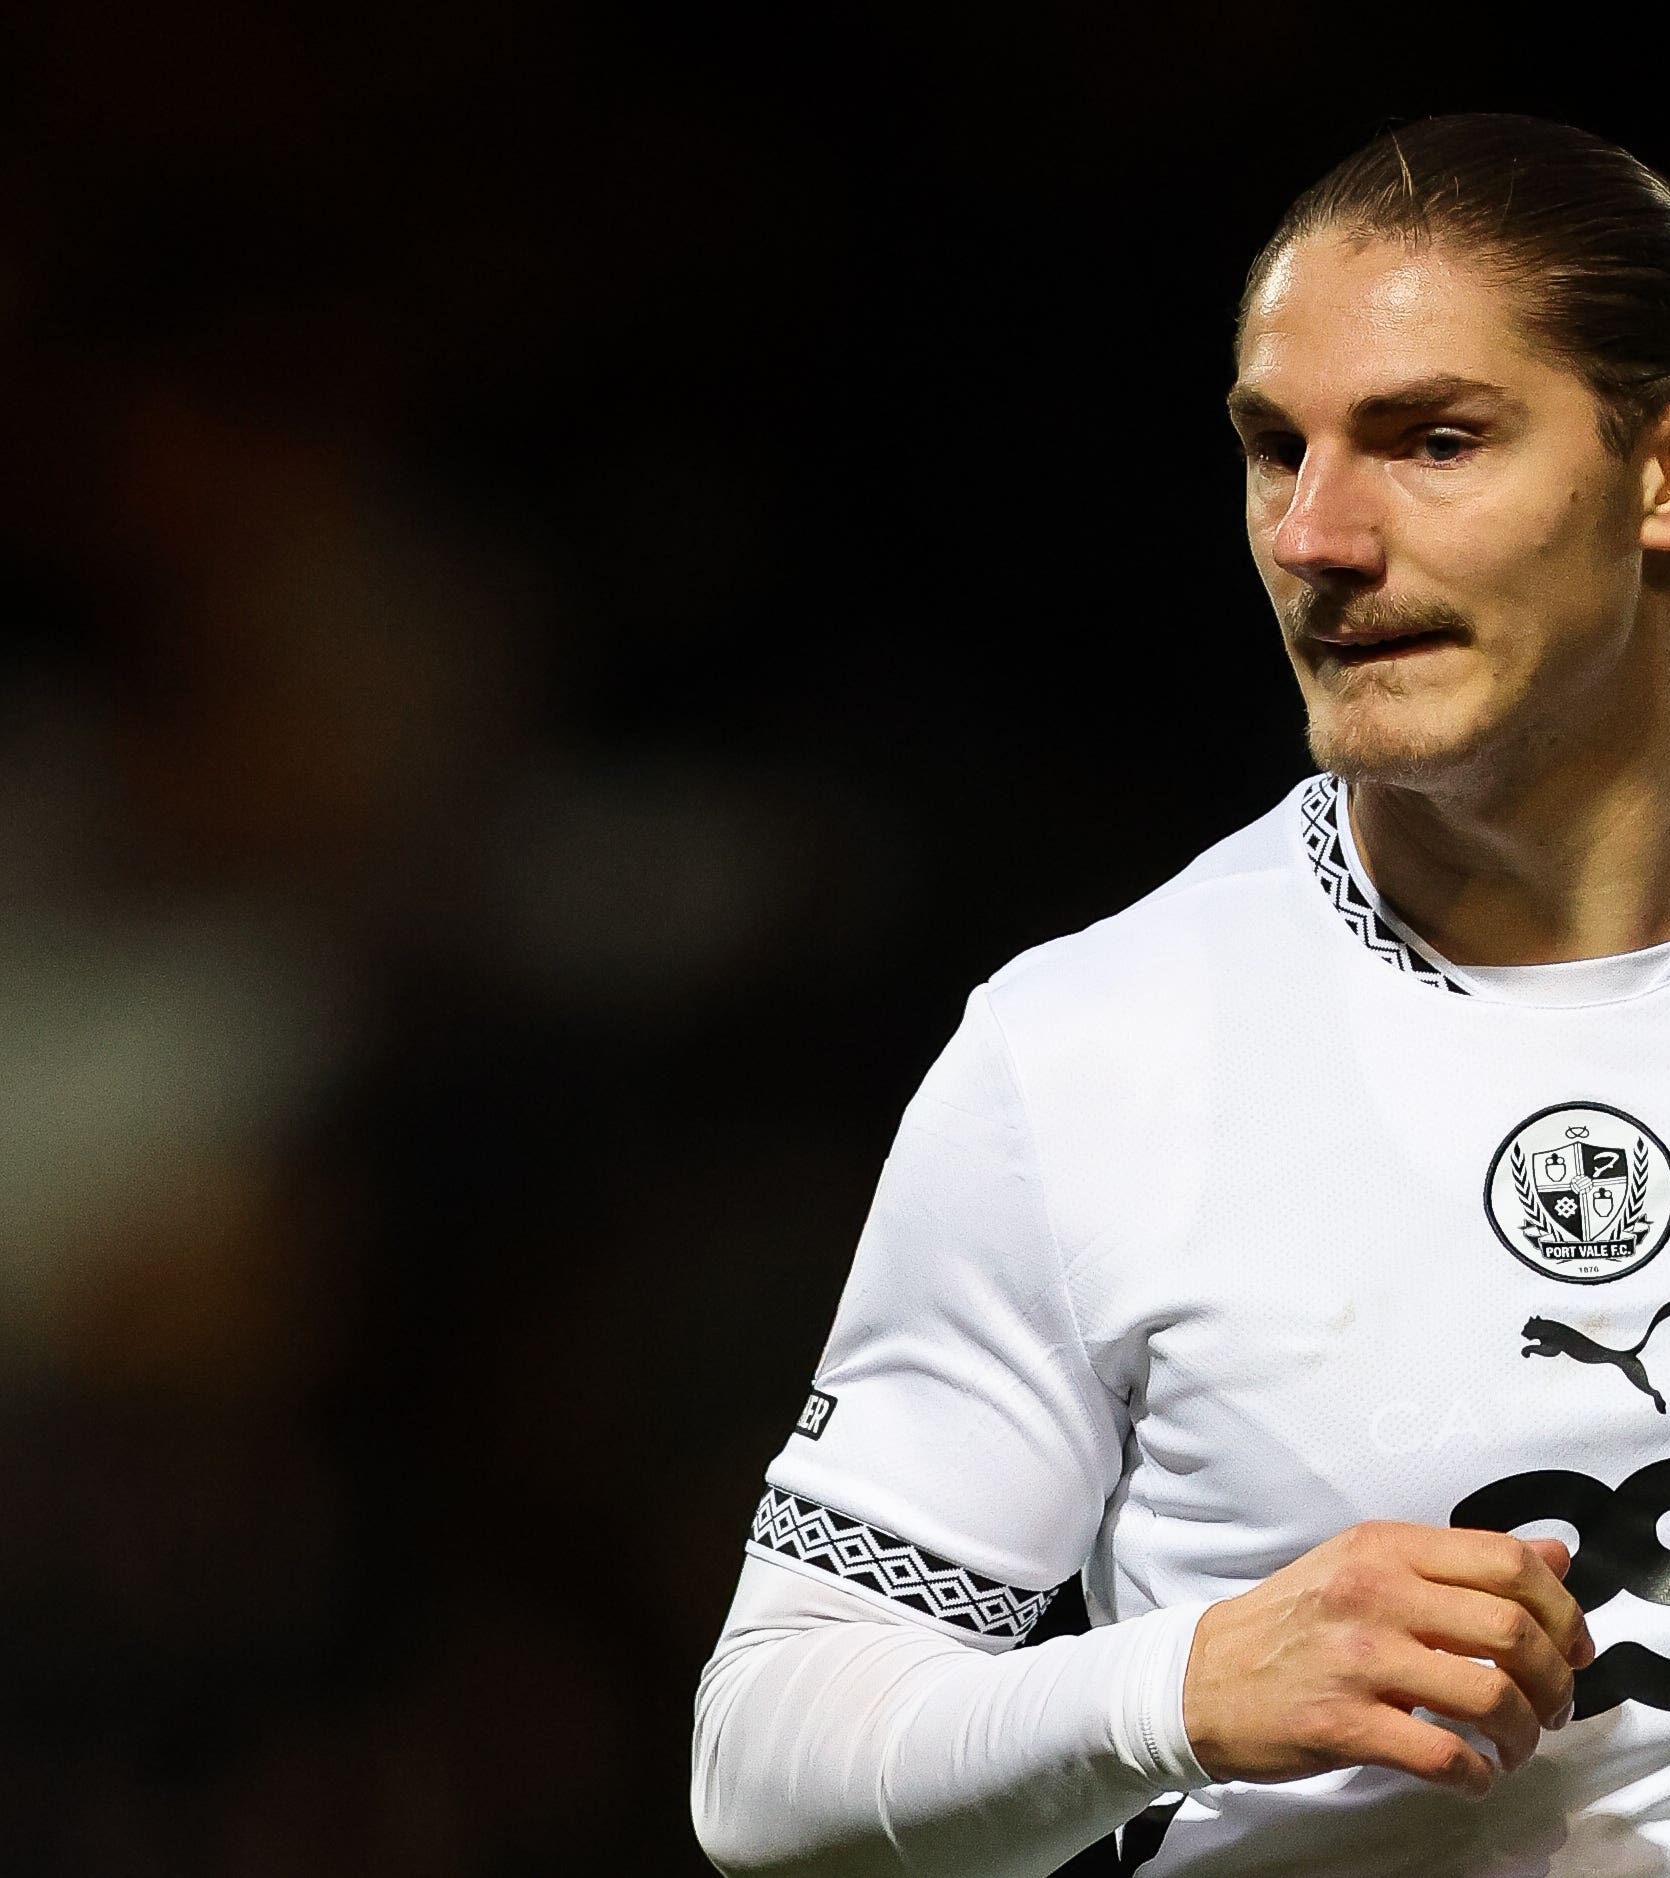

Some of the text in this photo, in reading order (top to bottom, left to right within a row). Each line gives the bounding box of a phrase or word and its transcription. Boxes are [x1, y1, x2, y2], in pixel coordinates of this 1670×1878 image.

[1545, 1244, 1631, 1258] PORT VALE F.C.
[1578, 1265, 1600, 1274] 1876
